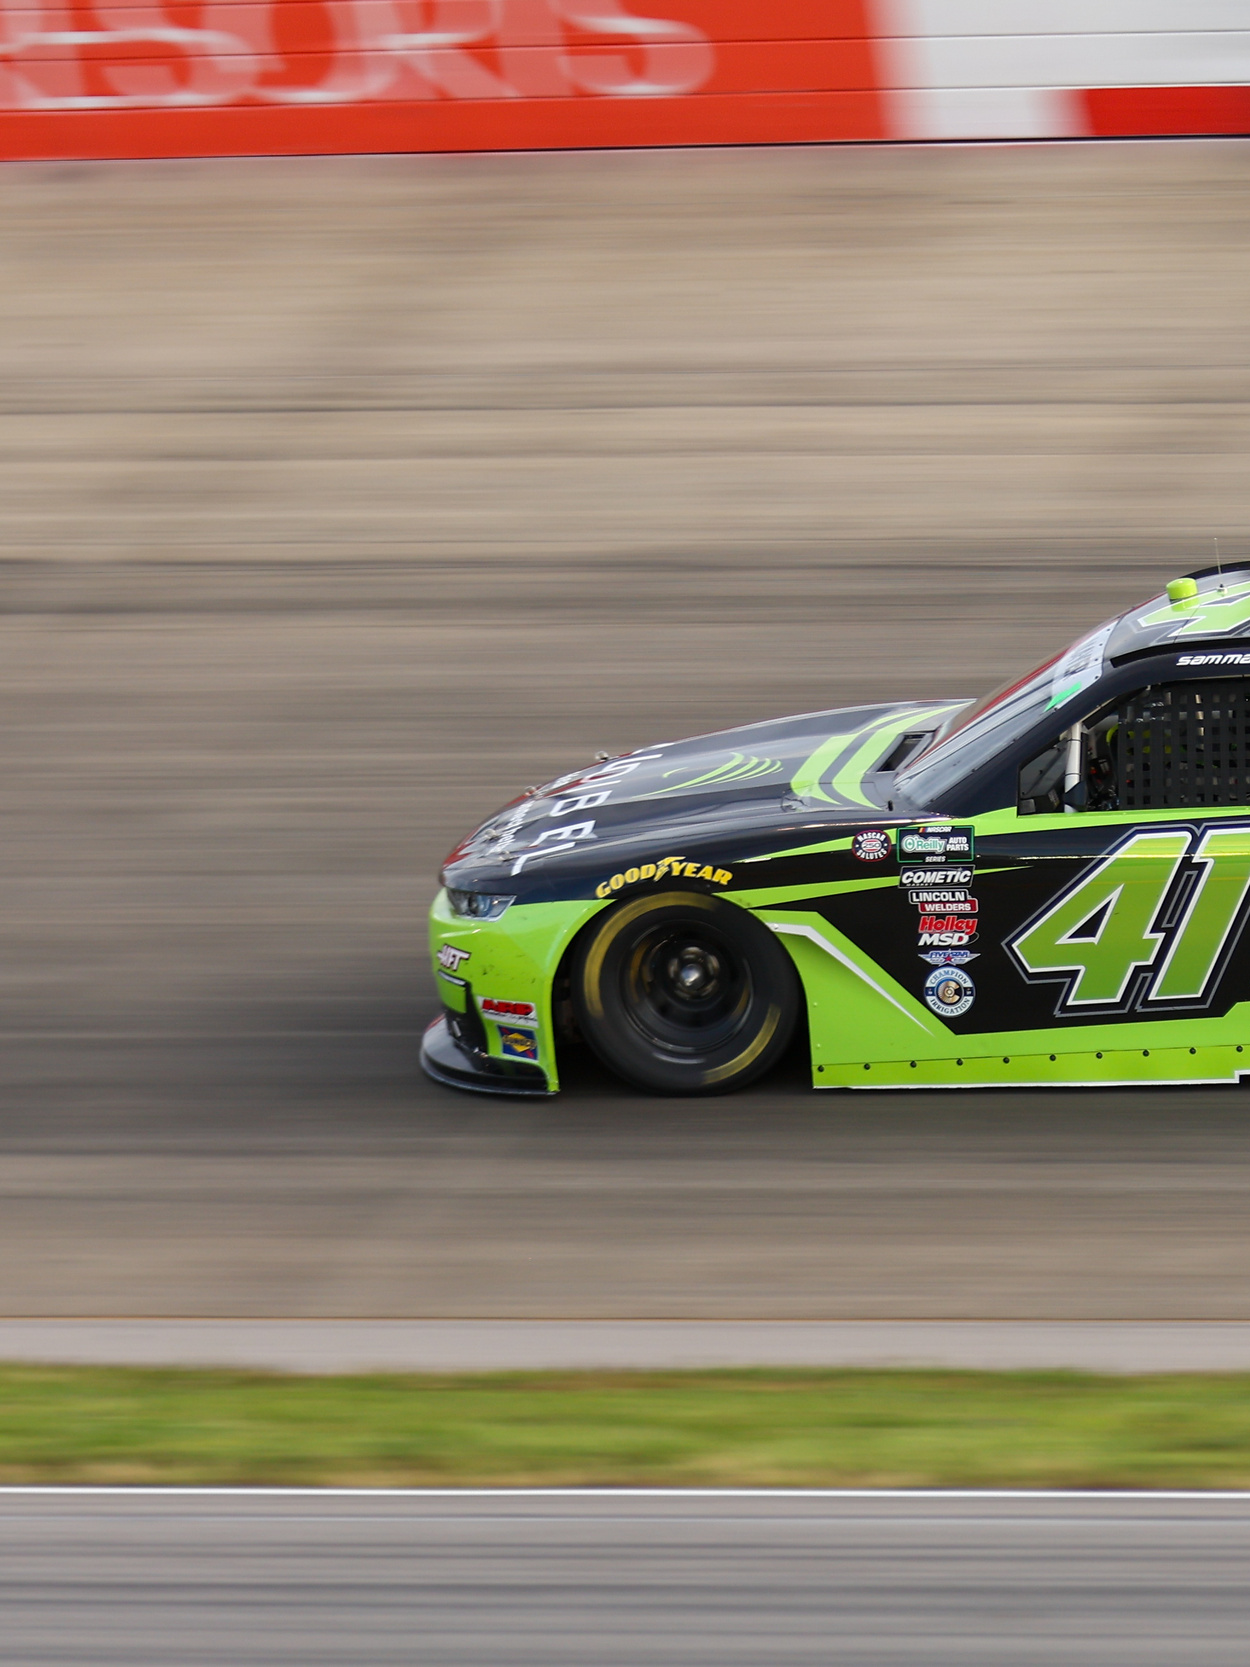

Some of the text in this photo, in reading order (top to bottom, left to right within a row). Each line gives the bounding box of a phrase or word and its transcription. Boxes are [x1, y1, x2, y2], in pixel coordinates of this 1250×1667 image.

[856, 832, 887, 843] NASCAR
[904, 836, 968, 853] O'Reilly AUTO
[856, 848, 888, 860] SALUTES
[946, 844, 970, 852] PARTS
[595, 856, 733, 899] GOODYEAR
[901, 869, 972, 884] COMETIC
[912, 891, 966, 902] LINCOLN
[924, 903, 972, 911] WELDERS
[919, 915, 978, 936] Holley
[918, 932, 971, 946] MSD
[929, 969, 969, 985] CHAMPION
[929, 997, 971, 1015] IRRIGATION
